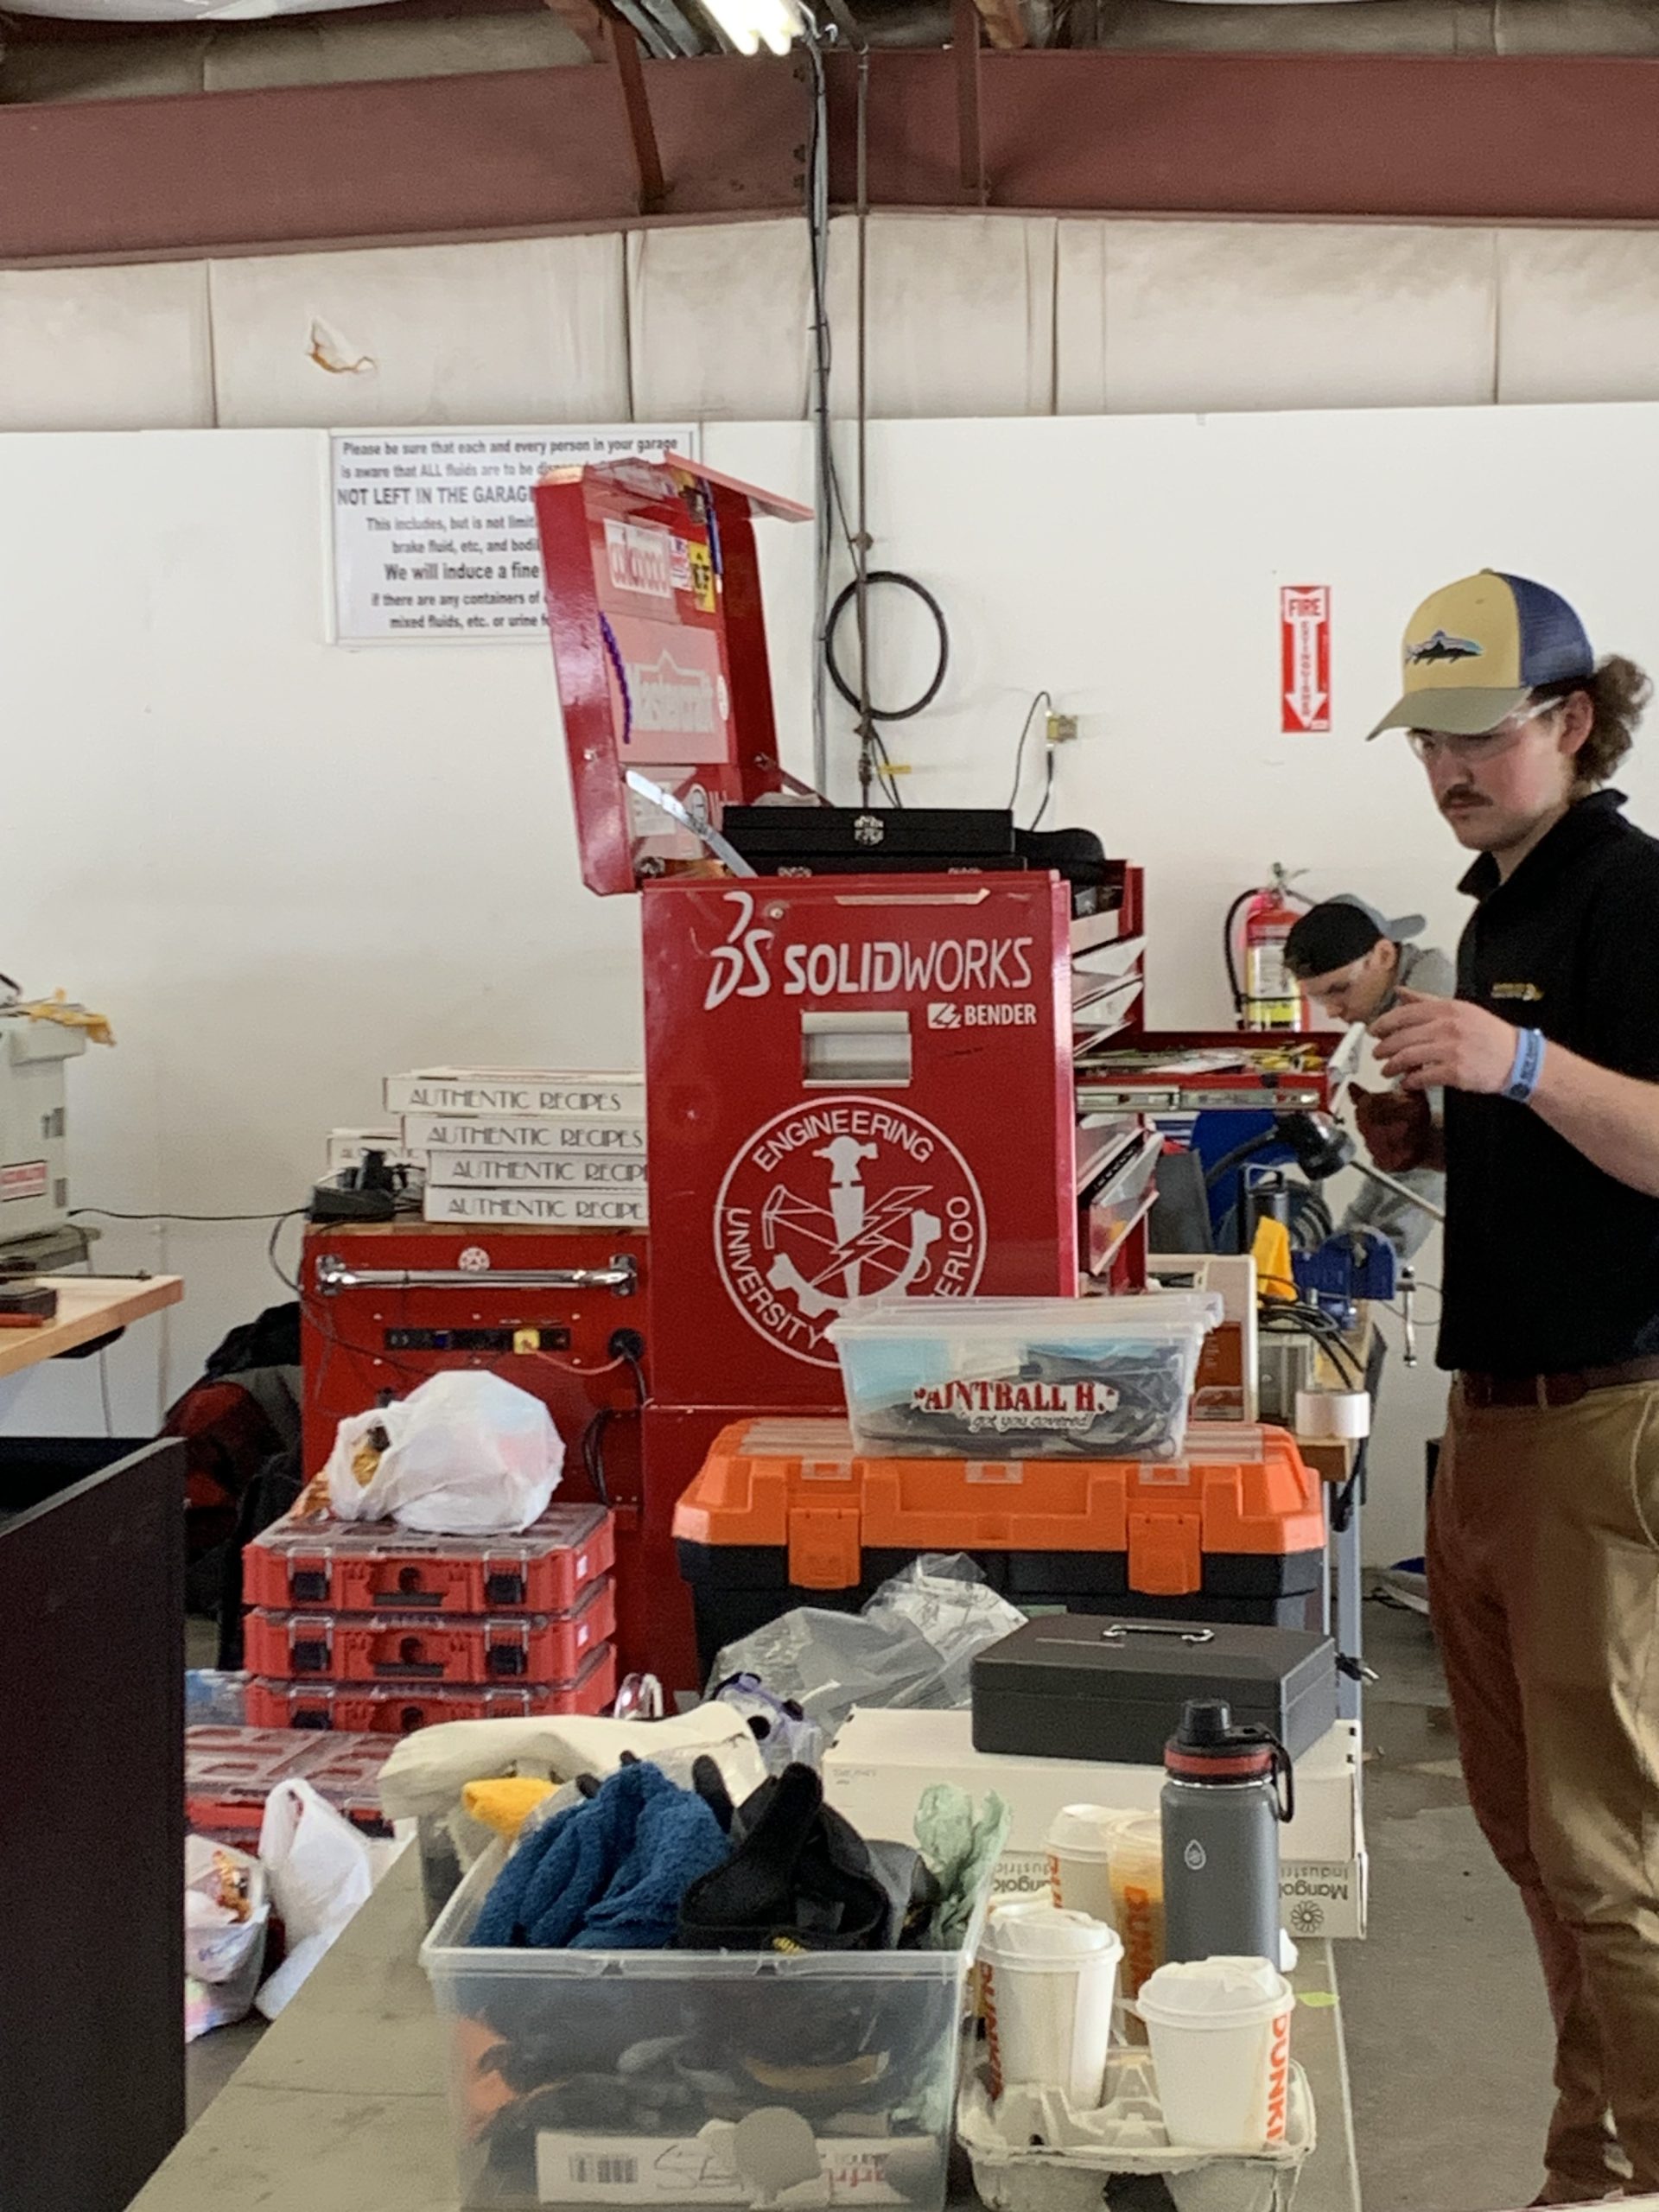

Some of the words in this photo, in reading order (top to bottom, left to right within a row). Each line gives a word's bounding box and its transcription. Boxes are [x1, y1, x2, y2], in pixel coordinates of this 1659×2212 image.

[342, 442, 381, 455] Please
[385, 442, 398, 454] be
[403, 443, 427, 454] sure
[432, 442, 454, 454] that
[458, 441, 486, 454] each
[490, 440, 511, 453] and
[514, 442, 546, 455] every
[550, 440, 591, 454] person
[594, 438, 604, 451] in
[607, 440, 633, 454] your
[638, 439, 678, 453] garage
[340, 465, 351, 478] is
[355, 467, 390, 478] aware
[393, 464, 416, 477] that
[421, 464, 442, 477] ALL
[446, 462, 477, 476] fluids
[481, 465, 500, 475] are
[504, 463, 516, 475] to
[519, 462, 534, 475] be
[337, 487, 369, 505] NOT
[373, 487, 410, 505] LEFT
[416, 486, 431, 504] IN
[437, 486, 468, 504] THE
[366, 517, 391, 531] This
[450, 516, 469, 530] but
[472, 516, 482, 530] is
[486, 517, 505, 529] not
[508, 515, 535, 528] limit
[391, 540, 425, 553] brake
[486, 538, 507, 552] and
[384, 563, 408, 581] We
[410, 563, 439, 580] will
[442, 562, 493, 579] induce
[498, 566, 507, 579] a
[512, 562, 540, 578] fine
[372, 592, 380, 606] if
[383, 592, 413, 606] there
[416, 594, 435, 605] are
[440, 594, 460, 608] any
[462, 592, 524, 605] containers
[528, 590, 540, 604] of
[1288, 598, 1321, 617] FIRE
[390, 614, 425, 628] mixed
[493, 616, 505, 627] or
[508, 613, 537, 626] urine
[783, 937, 1033, 996] SOLIDWORKS
[963, 1003, 1037, 1027] BENDER
[410, 1087, 531, 1110] AUTHENTIC
[539, 1090, 622, 1111] RECIPES
[427, 1125, 551, 1147] AUTHENTIC
[561, 1128, 645, 1148] RECIPES
[752, 1108, 935, 1173] ENGINEERING
[452, 1160, 575, 1181] AUTHENTIC
[585, 1162, 647, 1181] RECIP
[447, 1197, 567, 1217] AUTHENTIC
[575, 1199, 645, 1220] RECIPE
[930, 1196, 974, 1297] ERLOO
[725, 1208, 827, 1350] UNIVERSITY
[913, 1380, 1067, 1412] AINTBALL
[1000, 1415, 1027, 1431] you
[1281, 1866, 1348, 1880] Industri
[1279, 1880, 1349, 1901] Mangol
[1266, 2013, 1289, 2145] DUNKI
